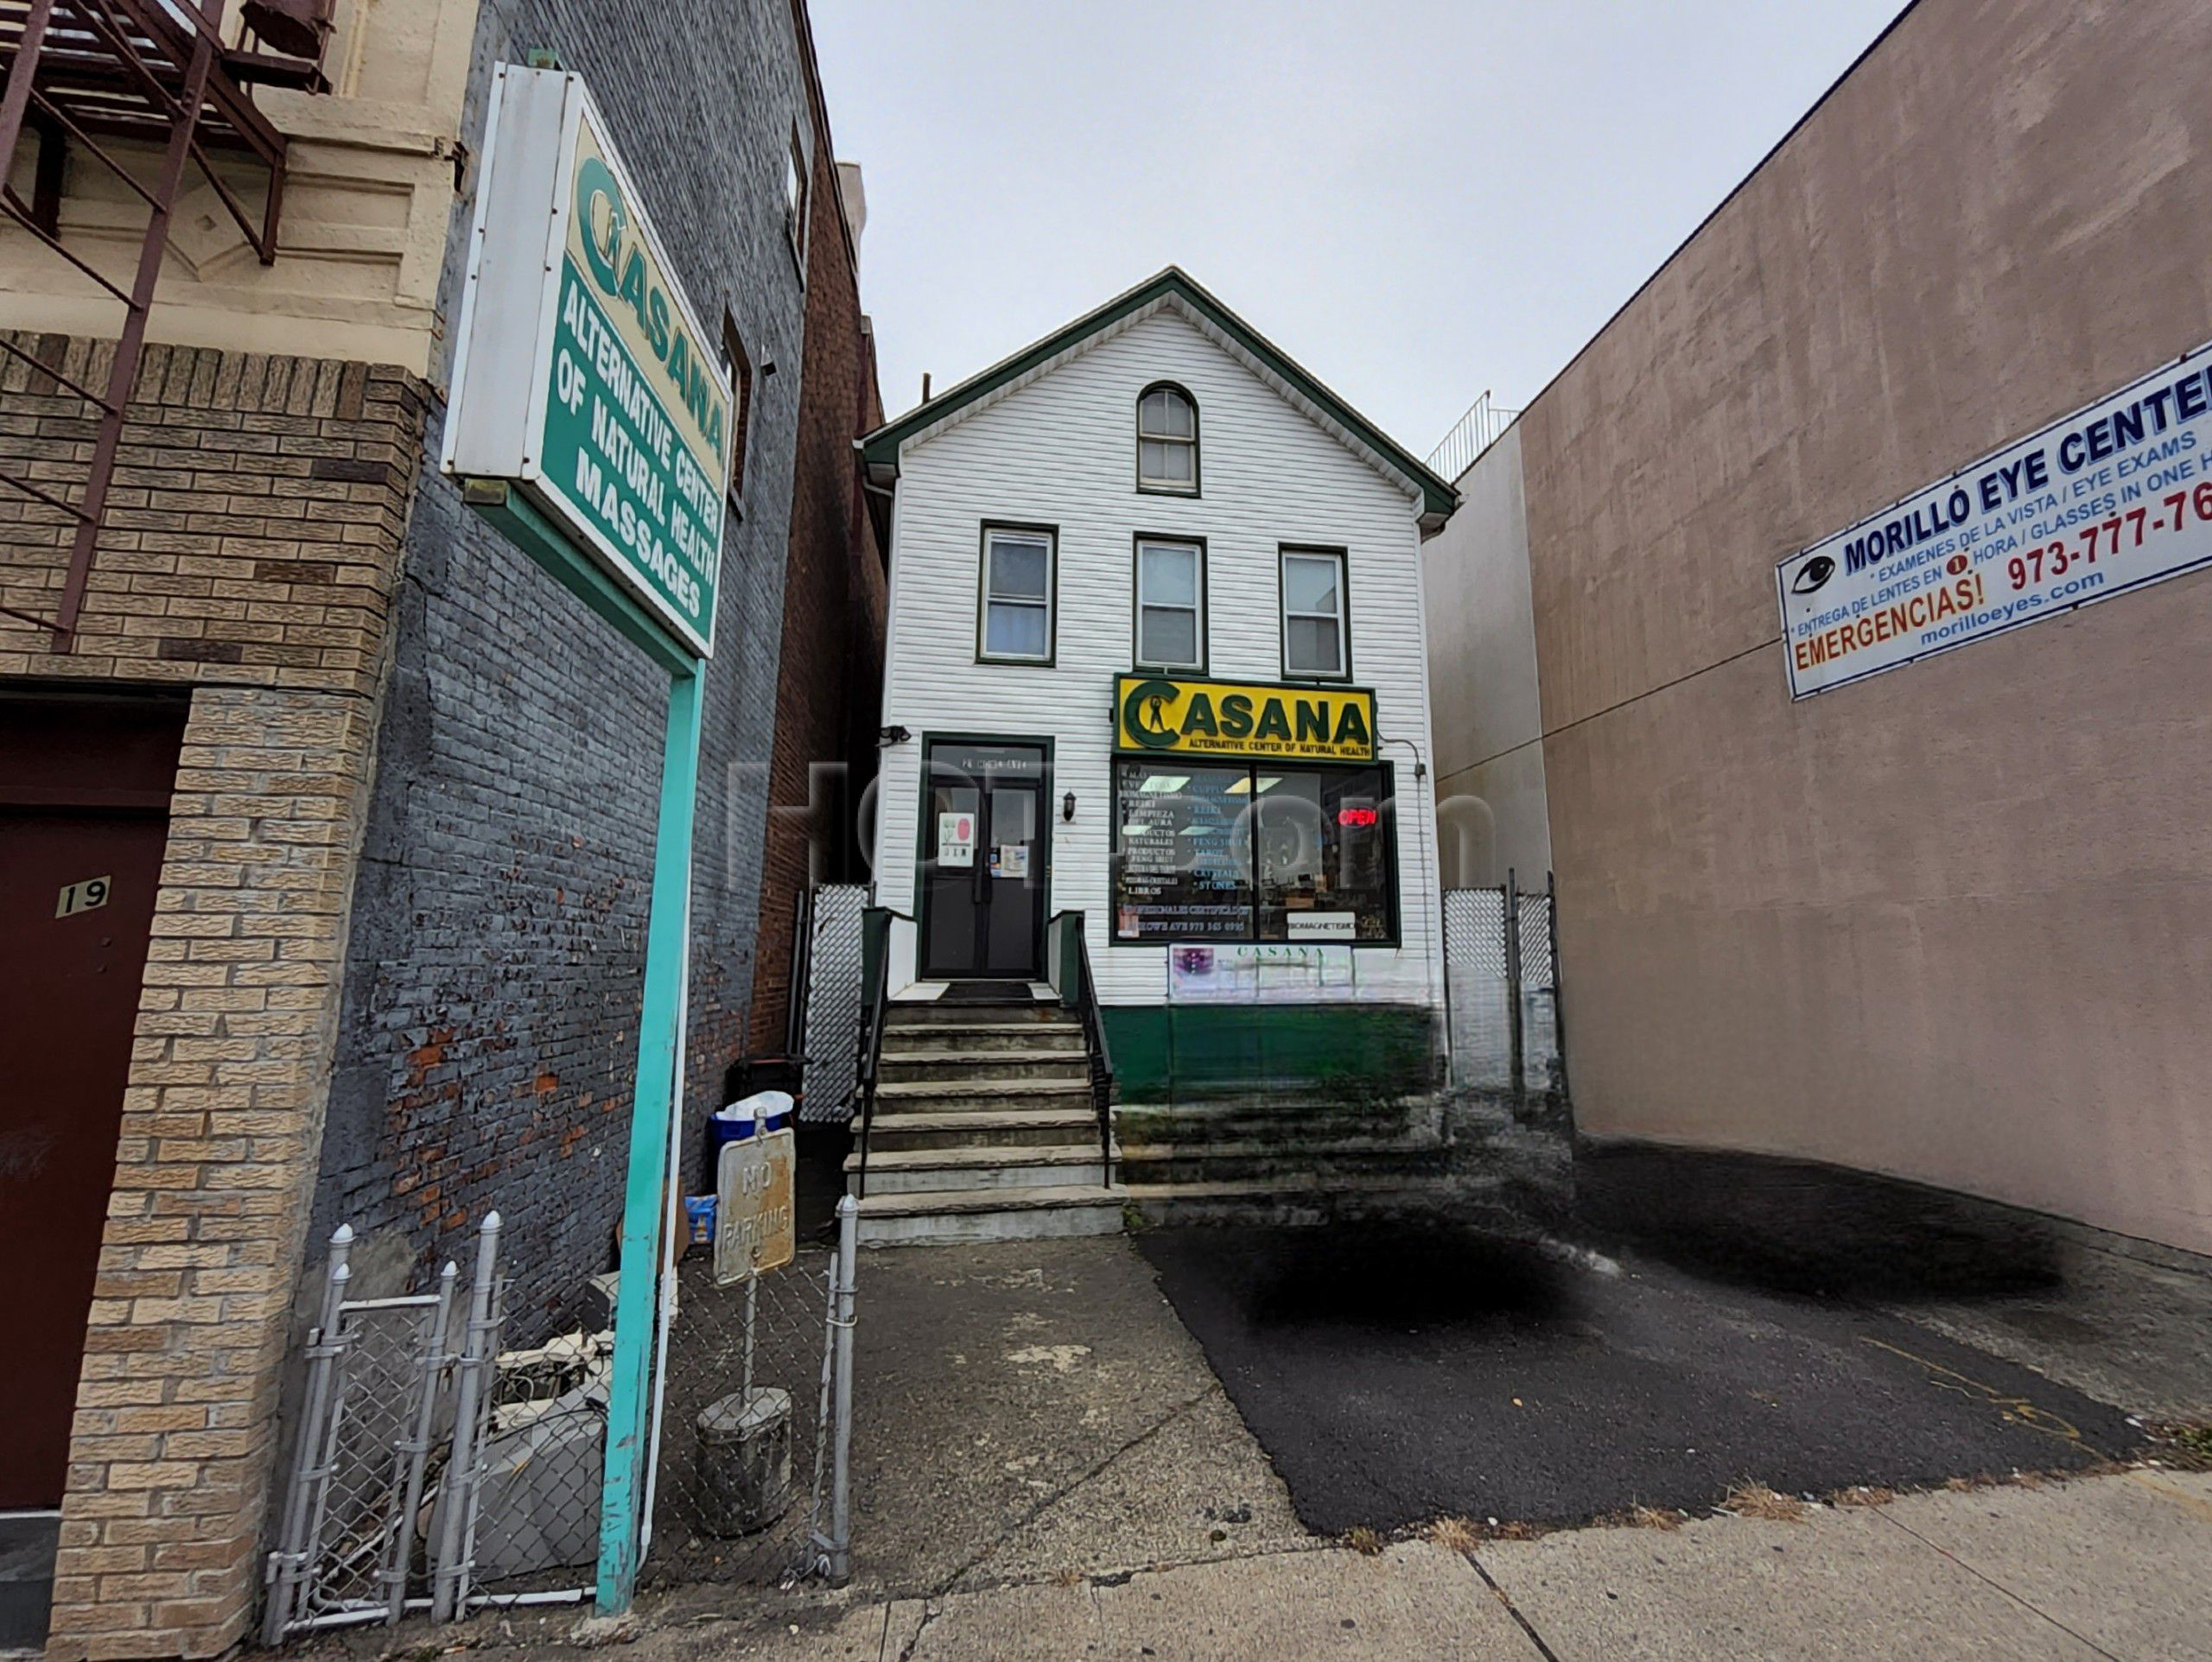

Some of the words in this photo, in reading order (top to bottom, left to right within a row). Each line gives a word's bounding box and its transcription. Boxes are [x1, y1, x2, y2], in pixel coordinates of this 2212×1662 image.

[576, 155, 724, 468] CASANA
[563, 279, 673, 472] ALTERNATIVE
[675, 447, 719, 538] CENTER
[556, 347, 587, 416] OF
[591, 392, 666, 527] NATURAL
[671, 498, 716, 587] HEALTH
[575, 445, 701, 619] MASSAGES
[1844, 488, 1972, 576] MORILLO
[1977, 447, 2049, 515] EYE
[1878, 538, 1956, 583] EXAMENES
[1959, 527, 1981, 549] DE
[1986, 517, 2005, 537] LA
[2007, 492, 2058, 525] VISTA
[2074, 466, 2113, 498] EYE
[2117, 430, 2197, 479] EXAMS
[1797, 606, 1850, 637] ENTREGA
[1852, 599, 1869, 618] DE
[1871, 576, 1921, 608] LENTES
[1923, 565, 1942, 586] EN
[1973, 534, 2018, 565] HORA
[2031, 492, 2117, 540] GLASSES
[2121, 481, 2142, 503] IN
[2146, 459, 2196, 492] ONE
[1795, 573, 1986, 671] EMERGENCIAS!
[1921, 571, 2105, 646] morilloeyes.com
[1123, 679, 1369, 749] CASANA
[1189, 739, 1245, 750] ALTERNATIVE
[1248, 740, 1283, 752] CENTER
[1284, 742, 1296, 752] OF
[1300, 743, 1336, 755] NATURAL
[1339, 745, 1370, 757] HEALTH
[1338, 809, 1377, 826] OPEN
[65, 880, 106, 914] 19
[1128, 886, 1162, 895] LIBROS
[1236, 946, 1325, 958] CASANA
[741, 1161, 772, 1196] NO
[723, 1205, 790, 1252] PARKING
